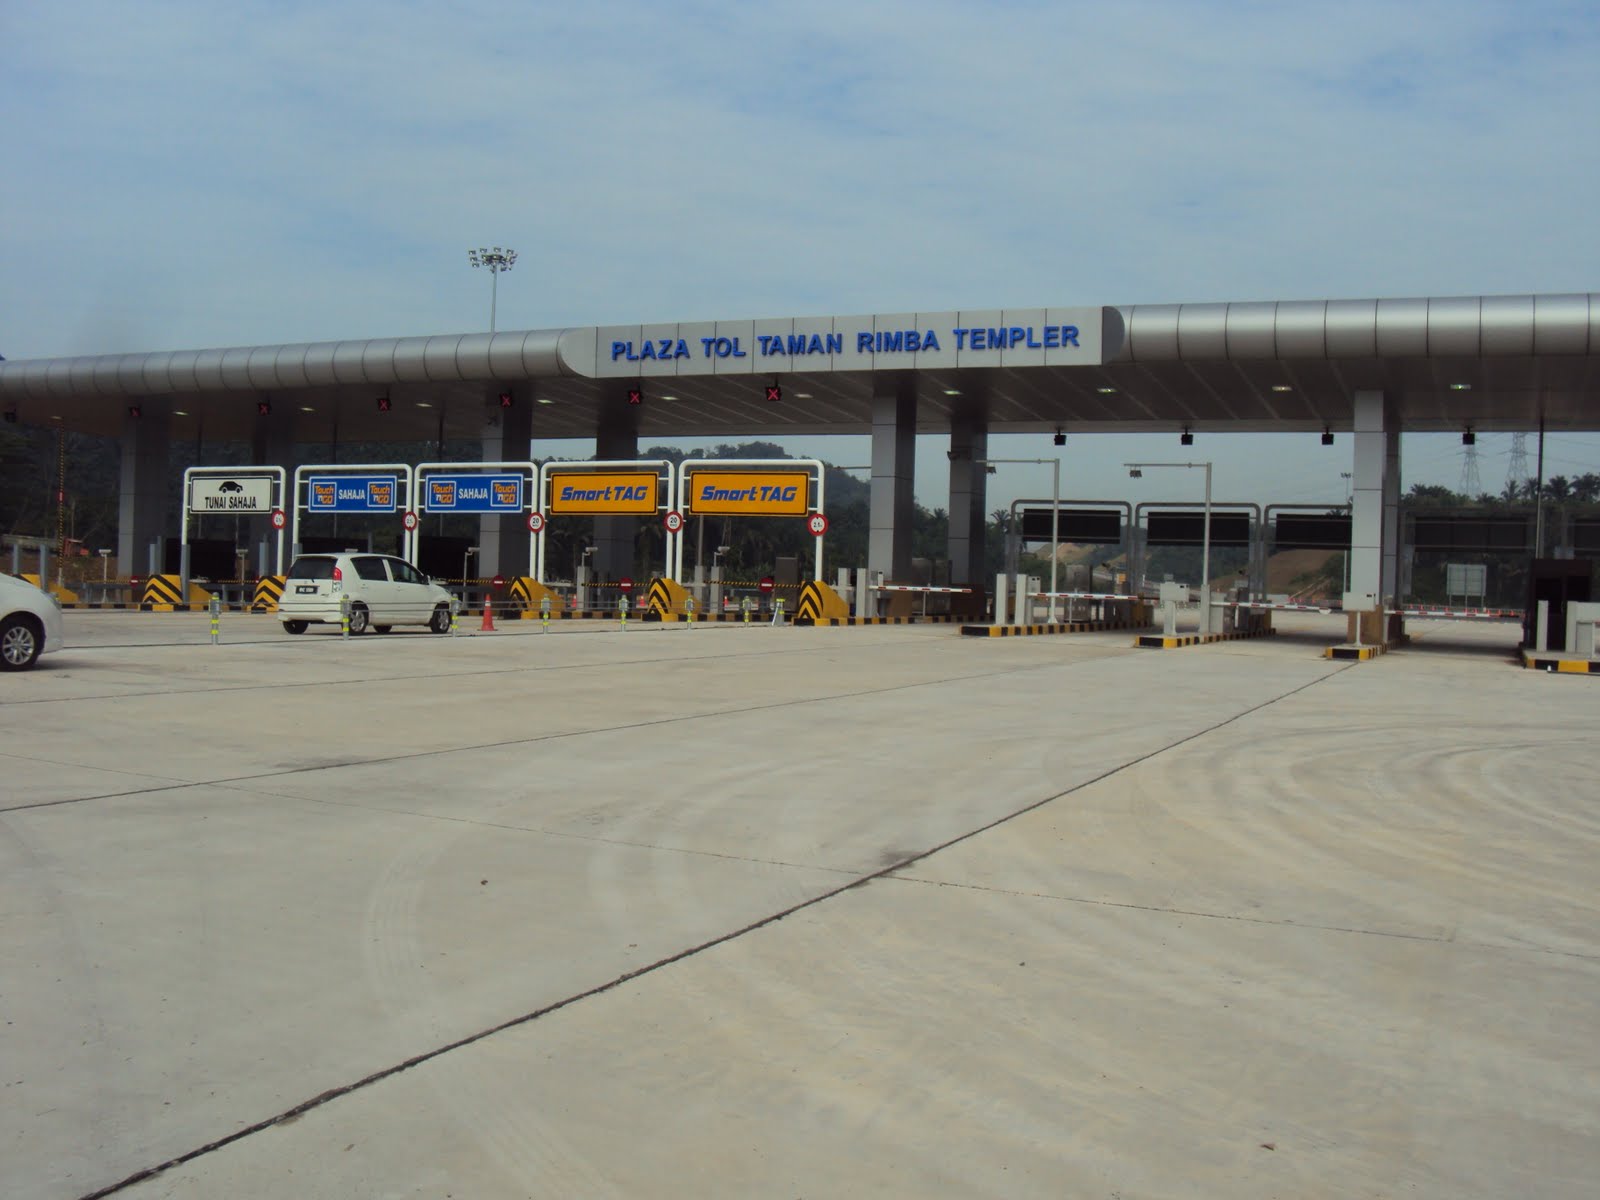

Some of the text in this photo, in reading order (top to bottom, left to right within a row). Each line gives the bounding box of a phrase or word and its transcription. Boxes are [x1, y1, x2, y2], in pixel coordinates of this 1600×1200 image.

[612, 325, 1080, 361] PLAZA TOL TAMAN RIMBA TEMPLER
[338, 489, 366, 500] SAHAJA
[458, 488, 488, 499] SAHAJA
[205, 496, 257, 509] TUNAI SAHAJA
